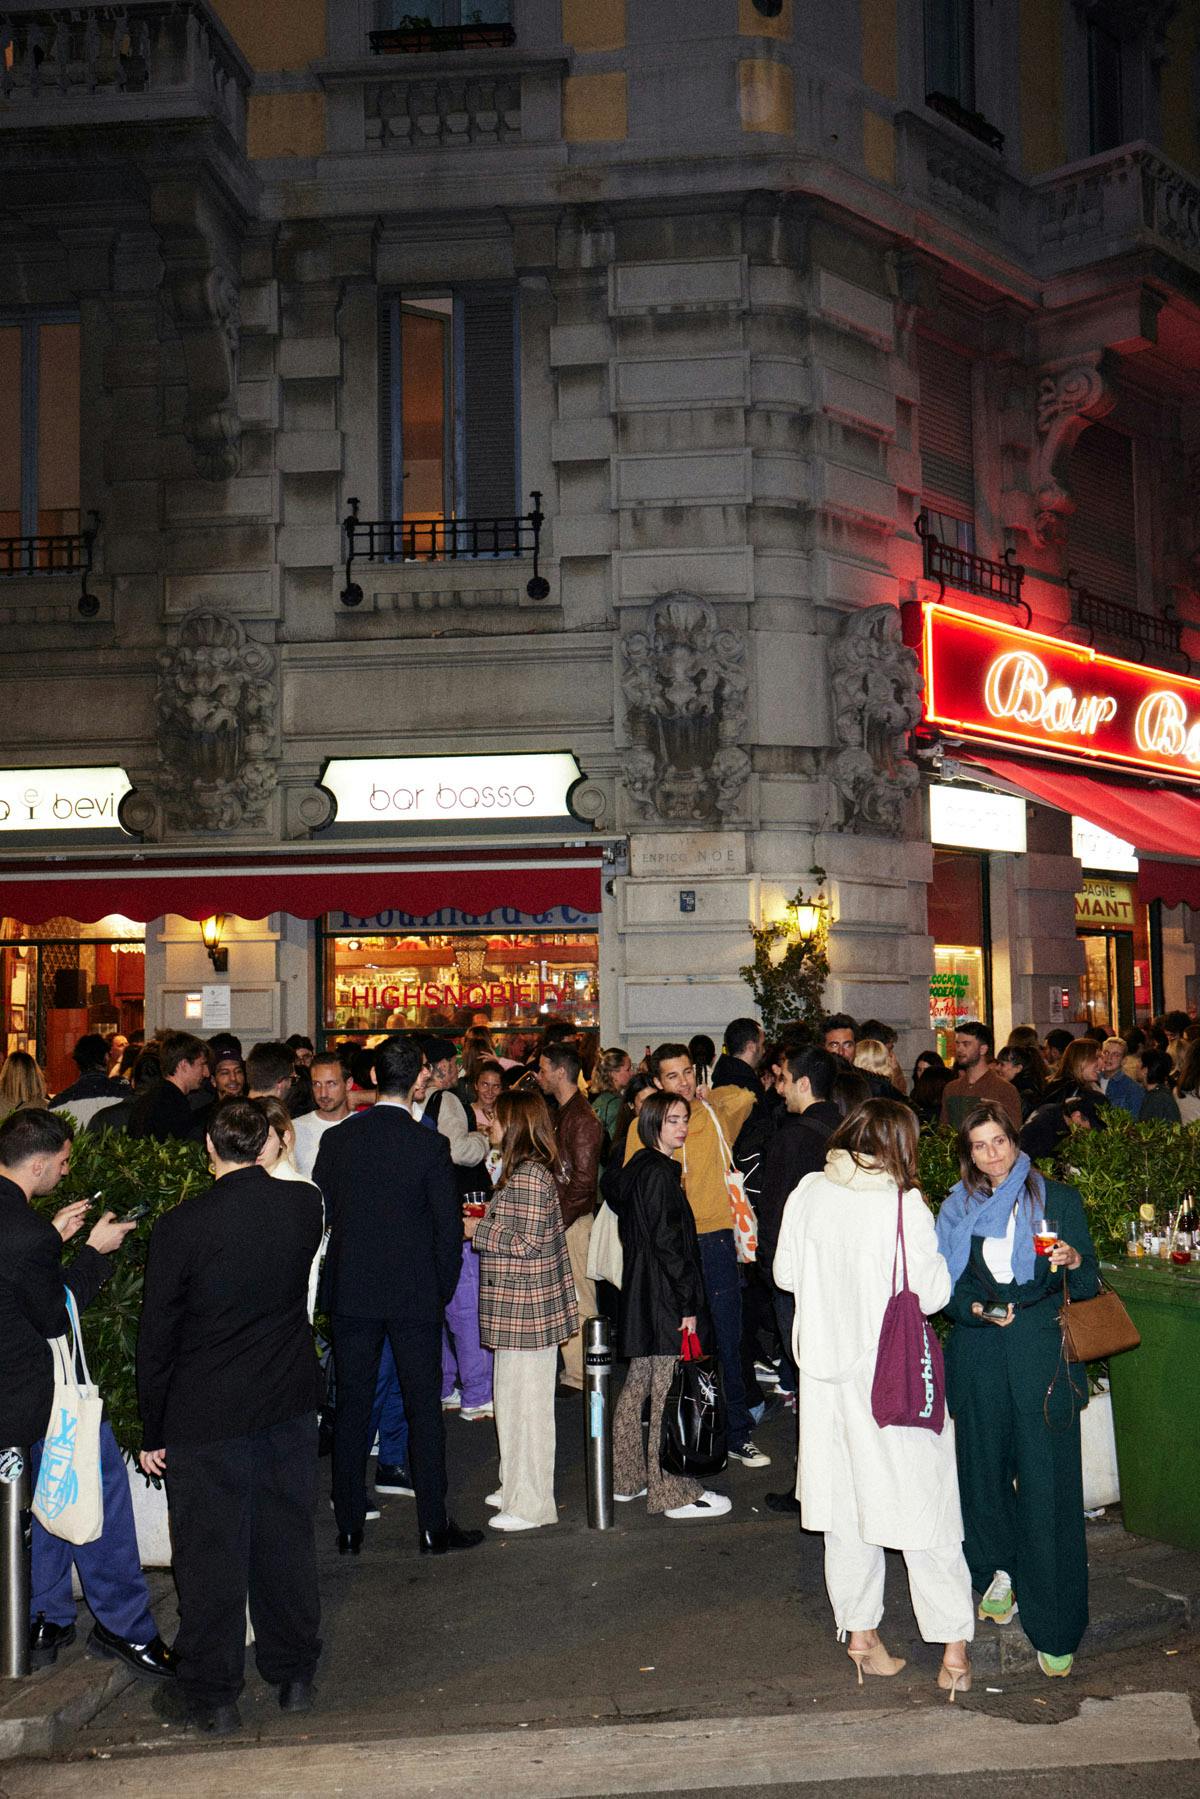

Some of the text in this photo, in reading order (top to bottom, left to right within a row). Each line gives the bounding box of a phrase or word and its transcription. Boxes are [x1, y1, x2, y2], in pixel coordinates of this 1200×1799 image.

[985, 651, 1117, 735] Bar
[52, 792, 114, 820] bevi
[369, 783, 535, 811] bar basso
[1080, 882, 1116, 898] PAGNE
[351, 980, 569, 1010] HIGHSNOBIETY
[918, 1320, 934, 1418] barbica
